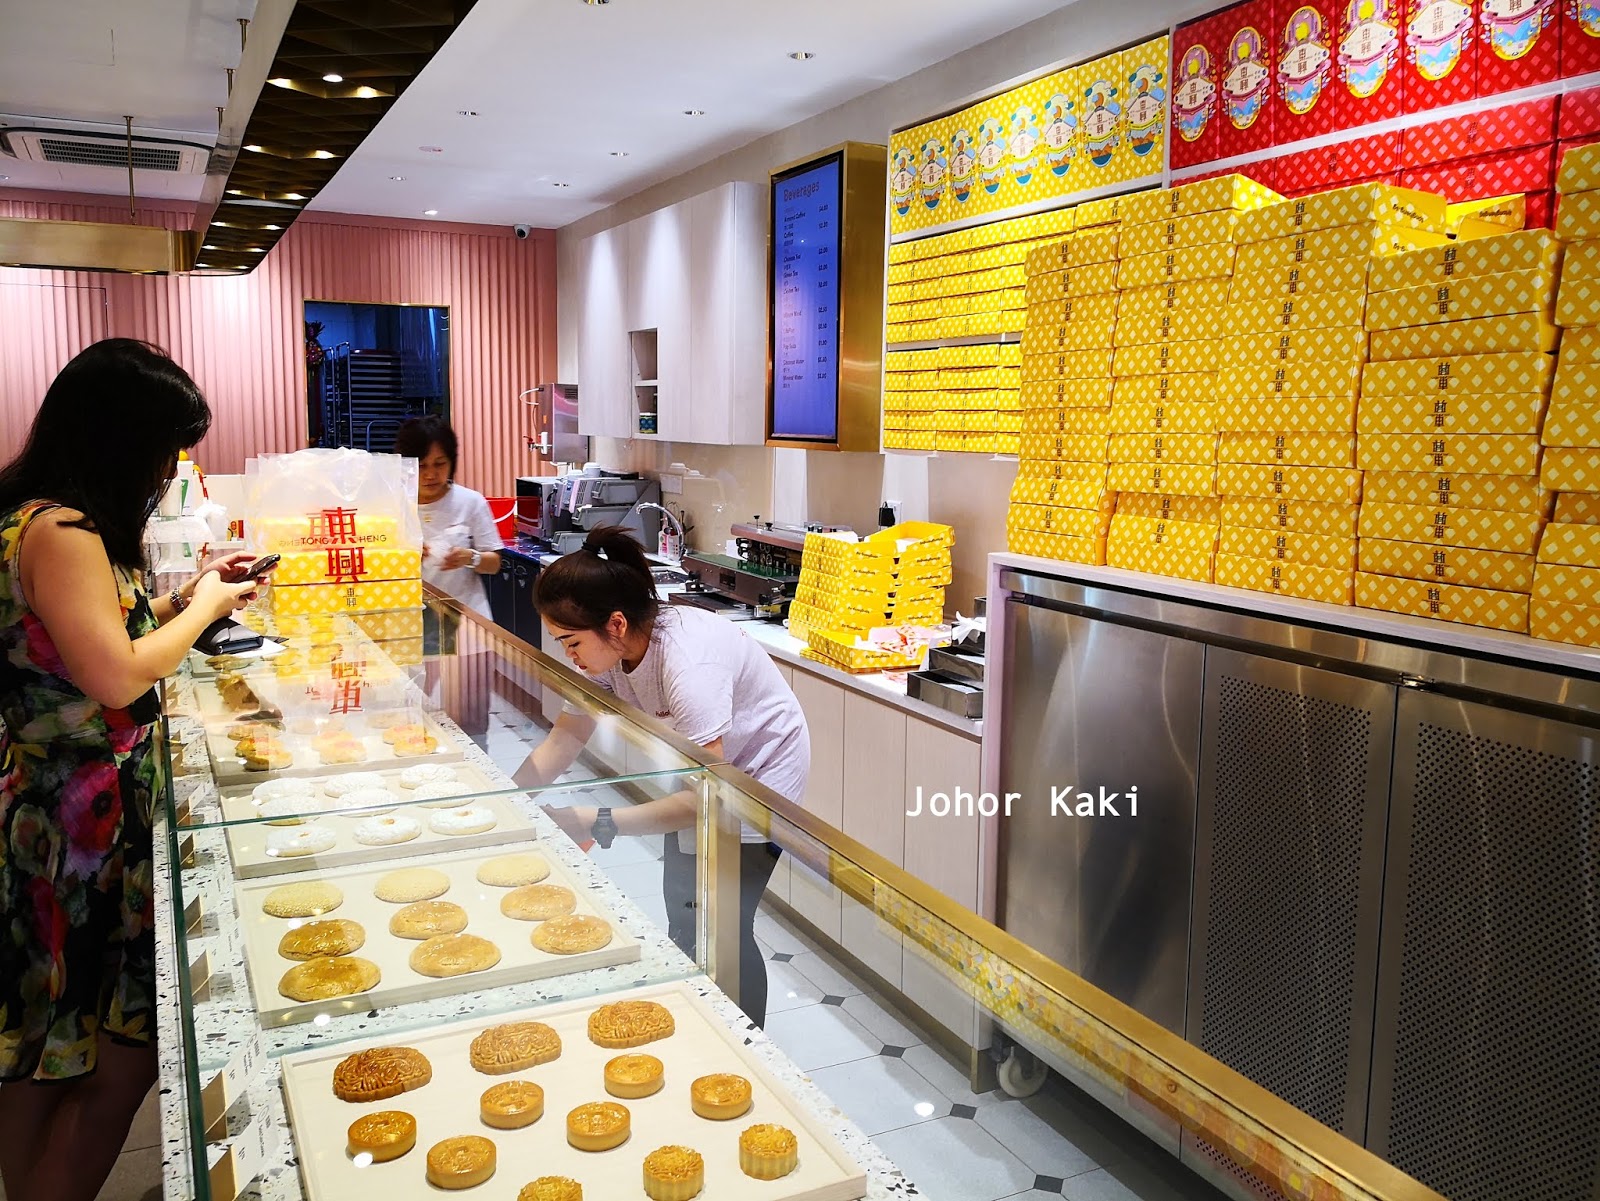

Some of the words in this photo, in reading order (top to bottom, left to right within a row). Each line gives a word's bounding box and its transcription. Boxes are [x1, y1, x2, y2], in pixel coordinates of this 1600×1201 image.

[784, 182, 820, 201] Beverages
[301, 537, 329, 546] TONG
[358, 534, 387, 543] HENG
[322, 507, 368, 584] 東興
